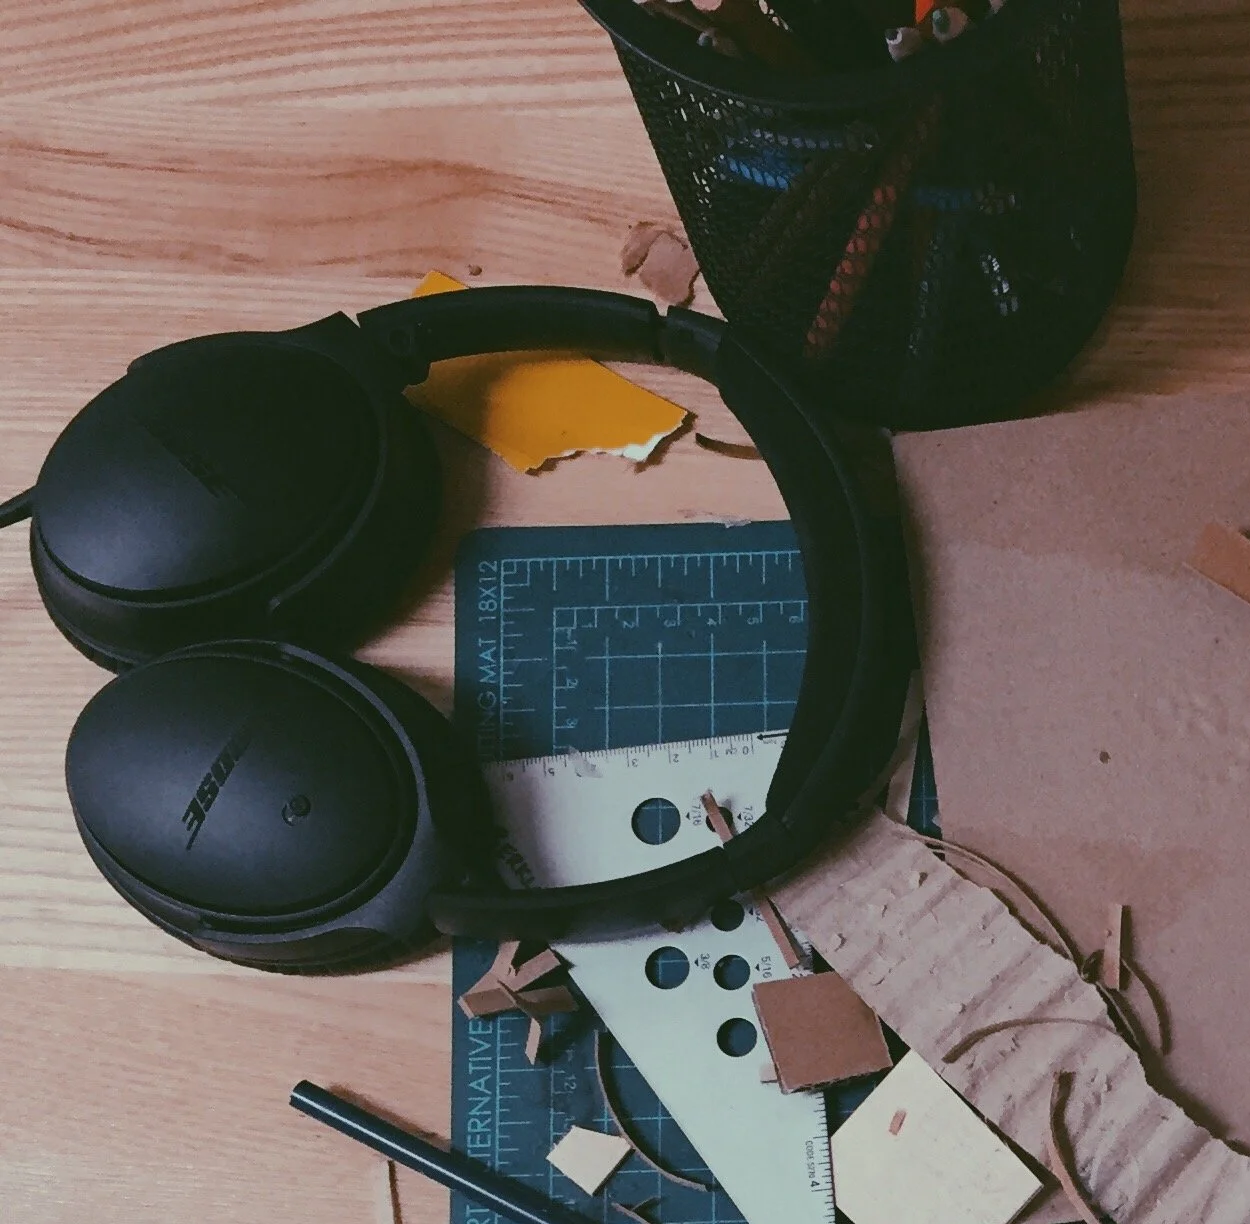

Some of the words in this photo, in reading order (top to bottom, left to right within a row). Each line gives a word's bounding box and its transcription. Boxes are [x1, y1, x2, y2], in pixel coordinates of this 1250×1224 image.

[478, 559, 498, 622] 18X12
[478, 637, 499, 684] MAT
[468, 1019, 493, 1168] TERNATIVE
